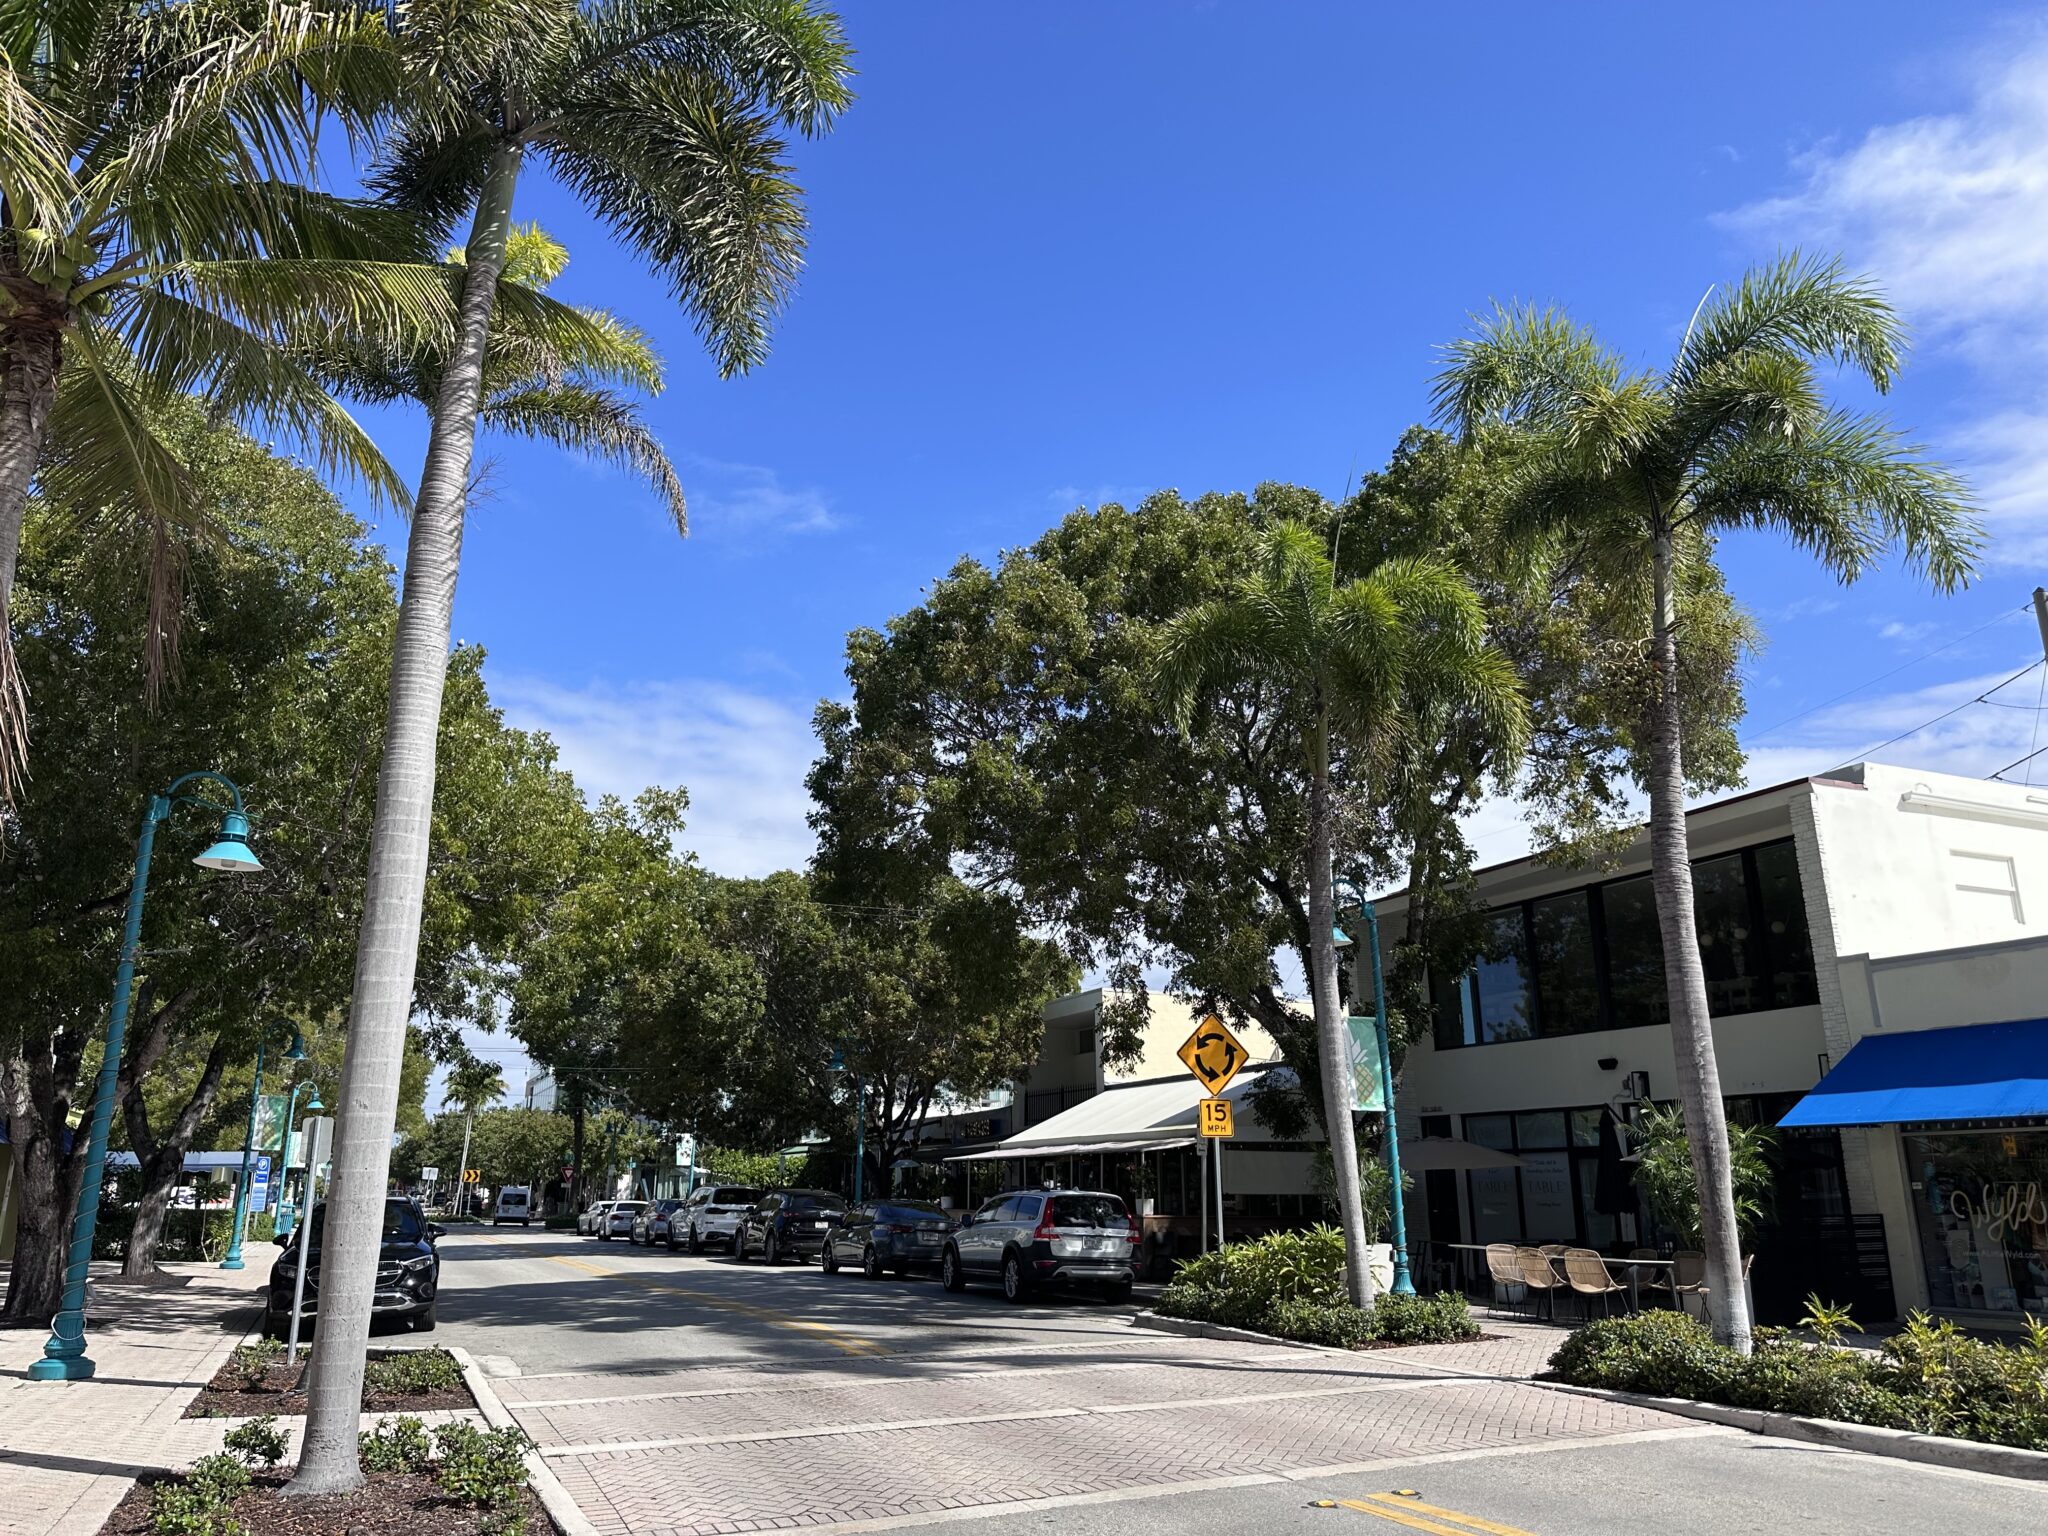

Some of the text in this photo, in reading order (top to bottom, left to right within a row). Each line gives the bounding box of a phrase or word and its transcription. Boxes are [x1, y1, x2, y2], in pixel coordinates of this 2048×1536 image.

[1206, 1104, 1227, 1122] 15
[1528, 1180, 1565, 1193] TABLE
[1951, 1183, 2047, 1241] Wyld
